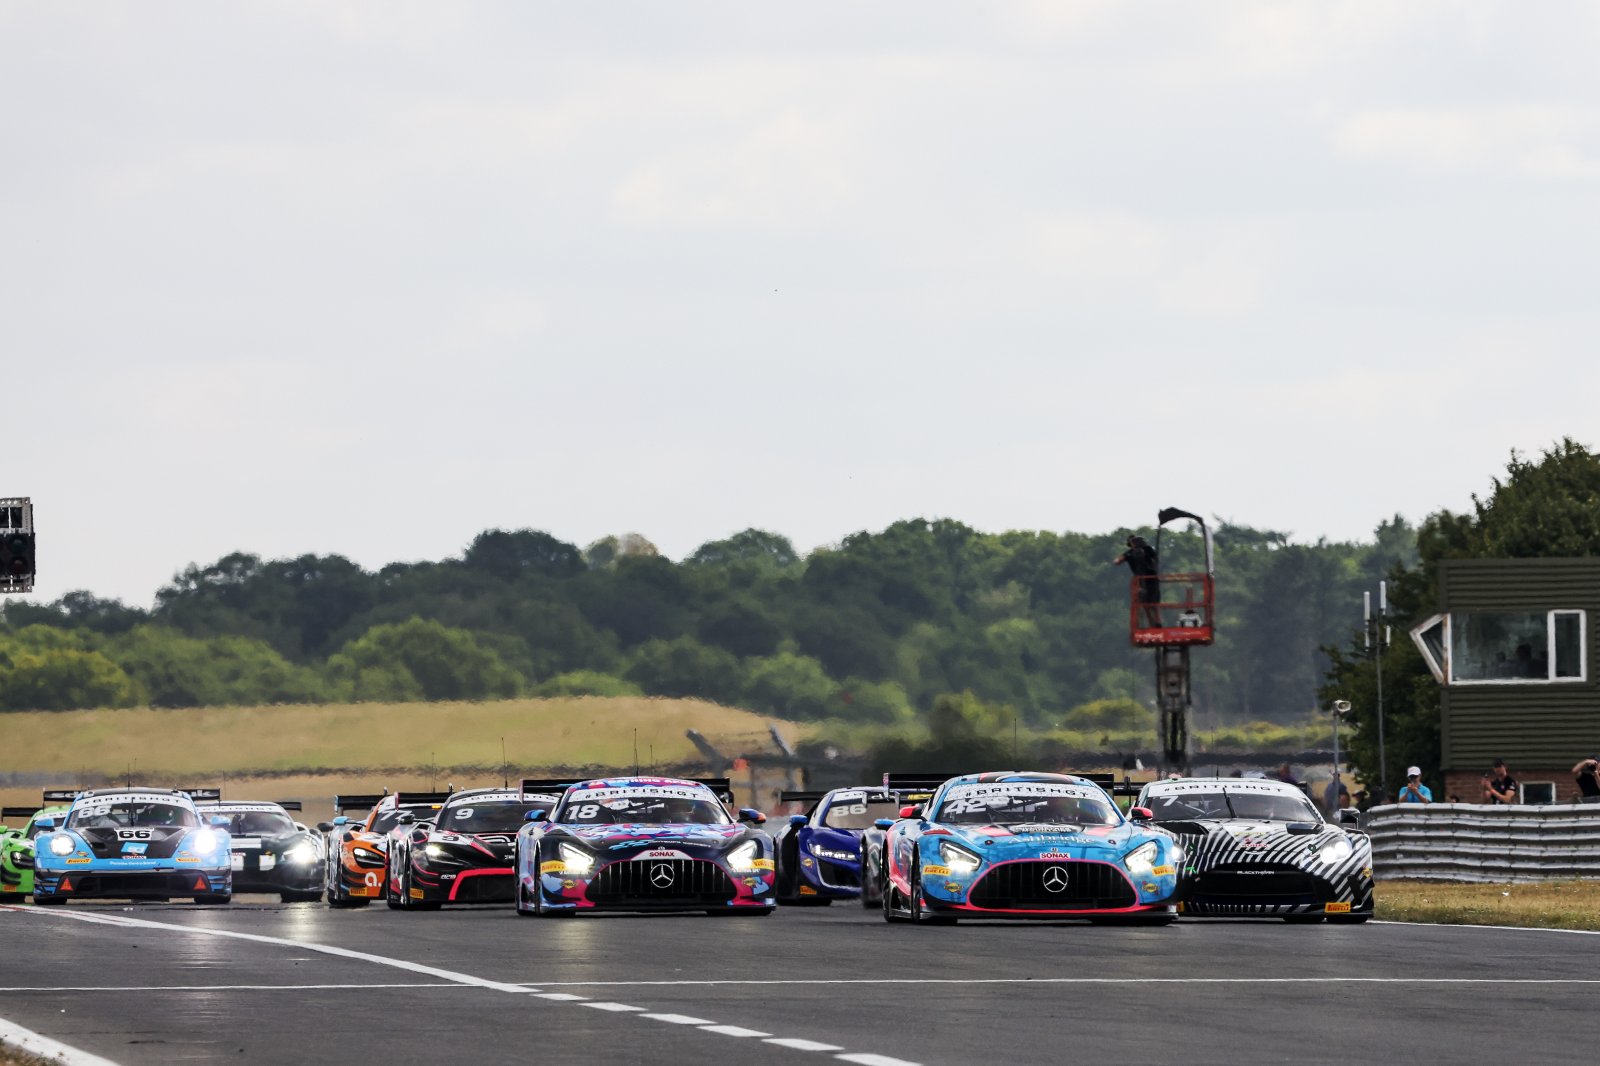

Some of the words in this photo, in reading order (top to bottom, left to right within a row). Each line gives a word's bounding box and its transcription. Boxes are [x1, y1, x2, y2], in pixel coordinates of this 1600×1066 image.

[585, 787, 699, 799] #BRITISHGT
[965, 785, 1090, 798] #BRITISHGT
[1164, 783, 1285, 793] #BRITISHGT
[943, 798, 988, 816] 42
[1160, 795, 1179, 807] 7
[78, 806, 112, 818] 66
[454, 808, 475, 820] 9
[566, 804, 601, 820] 18
[831, 804, 868, 818] 86
[119, 830, 152, 839] 66
